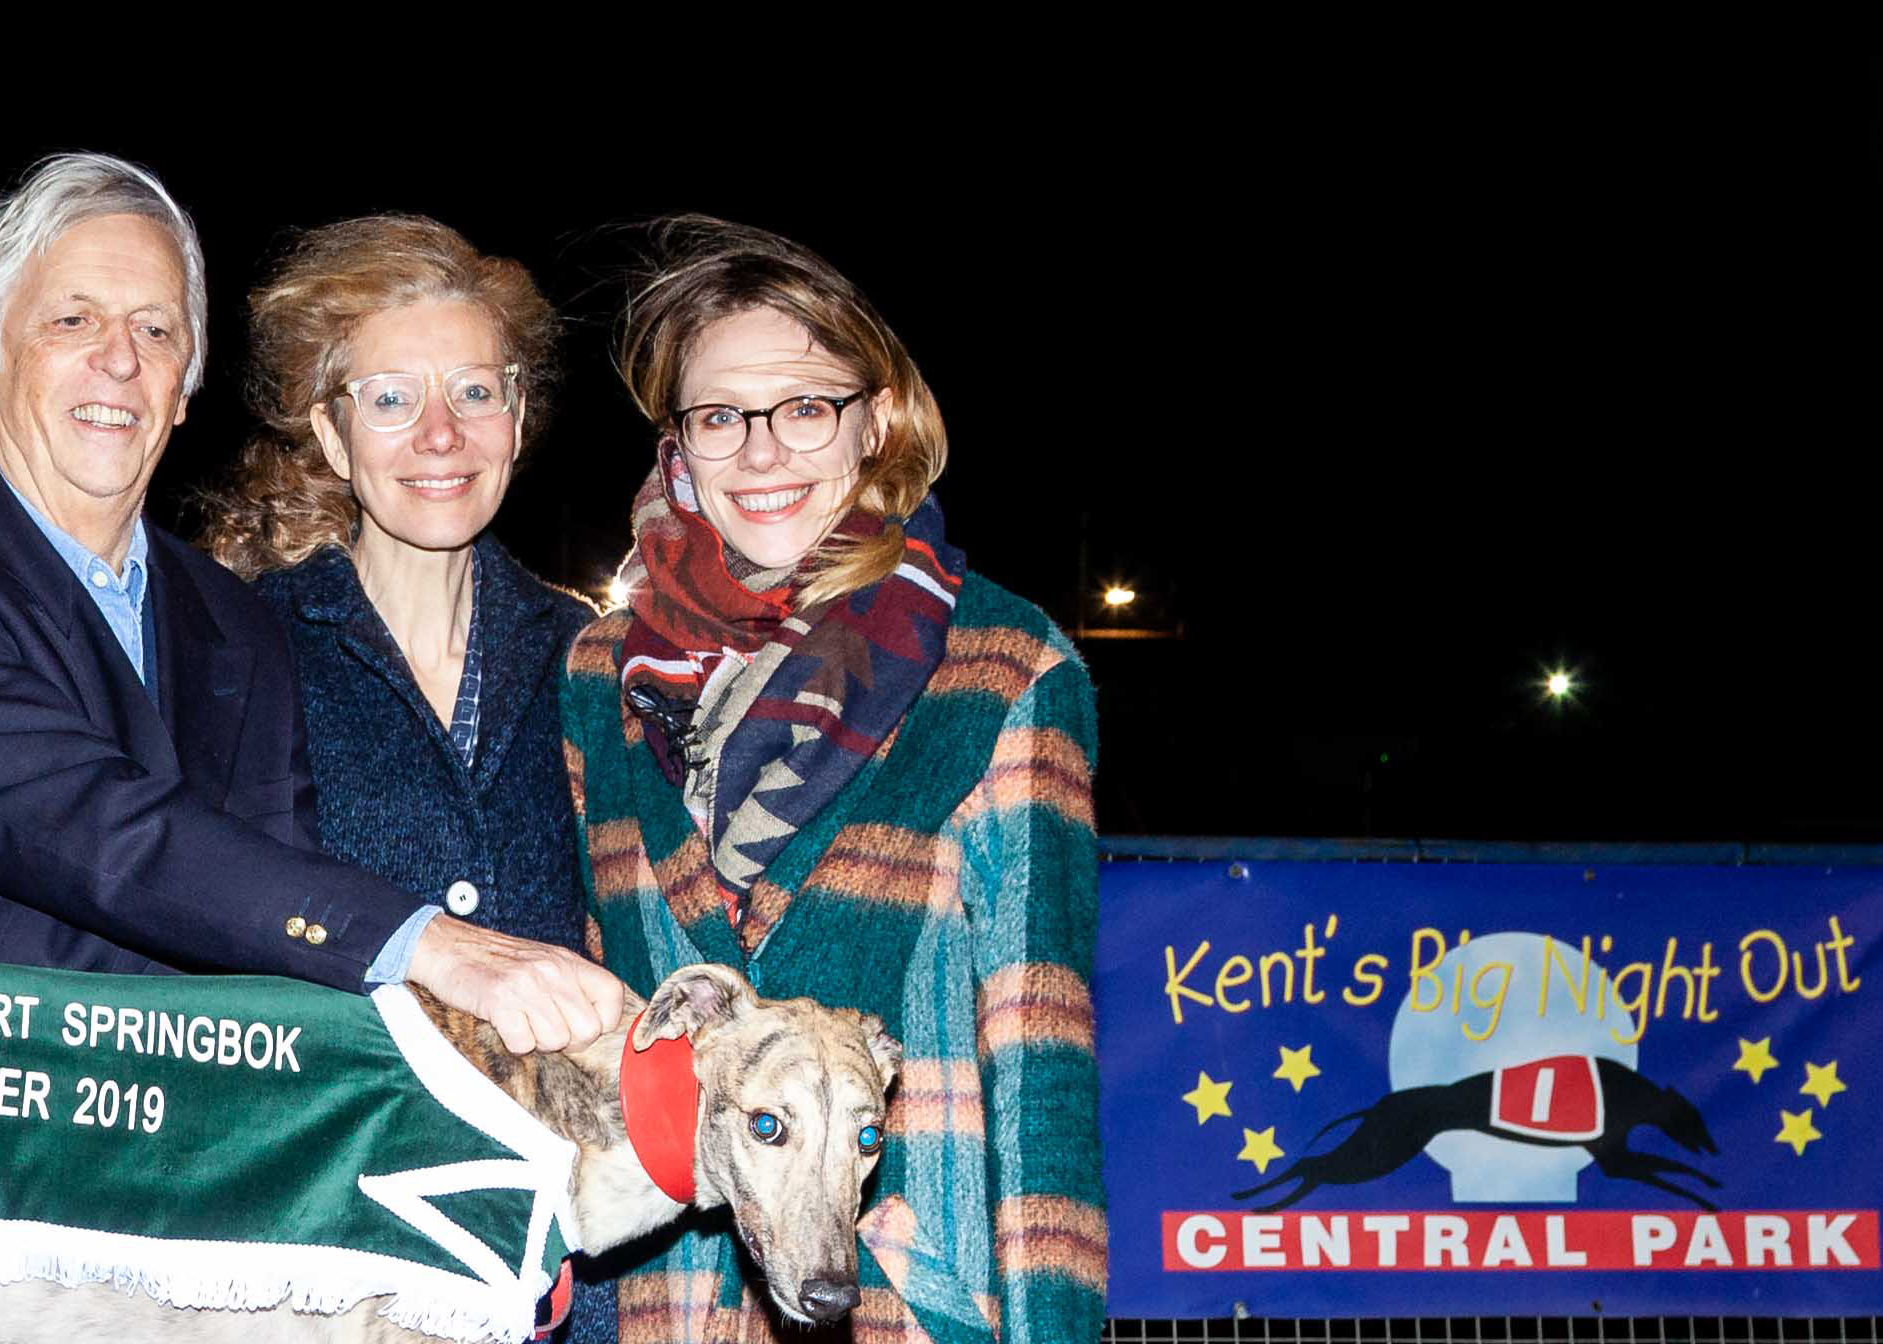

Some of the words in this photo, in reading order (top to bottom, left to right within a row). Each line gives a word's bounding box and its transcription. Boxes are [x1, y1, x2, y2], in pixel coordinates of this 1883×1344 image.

[1164, 914, 1389, 1025] Kent's
[1408, 927, 1515, 1042] Big
[1537, 935, 1722, 1046] Night
[1738, 916, 1863, 1003] Out
[61, 1001, 304, 1074] SPRINGBOK
[72, 1076, 166, 1135] 2019
[1175, 1214, 1588, 1268] CENTRAL
[1631, 1214, 1861, 1267] PARK
